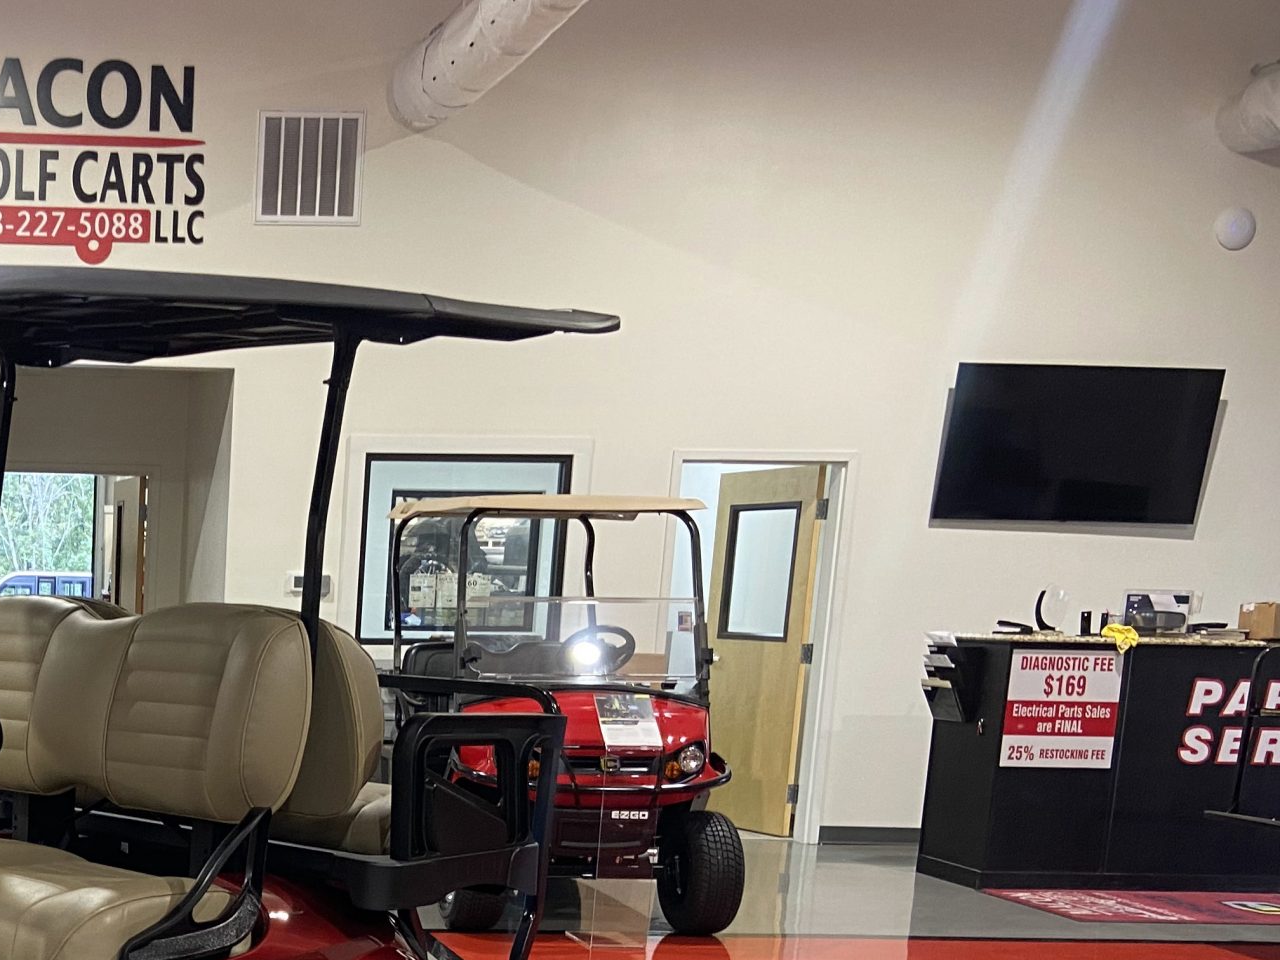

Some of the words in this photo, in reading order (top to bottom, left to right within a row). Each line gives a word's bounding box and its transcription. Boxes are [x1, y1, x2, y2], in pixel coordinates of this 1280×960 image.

[72, 150, 206, 206] CARTS
[154, 209, 205, 245] LLC
[1020, 655, 1090, 672] DIAGNOSTIC
[1093, 657, 1115, 672] FEE
[1043, 673, 1087, 698] $169
[1012, 703, 1056, 718] Electrical
[1058, 704, 1083, 718] Parts
[1085, 705, 1111, 719] Sales
[1036, 722, 1052, 733] are
[1054, 719, 1083, 733] FINAL
[1007, 745, 1035, 761] 25%
[1039, 748, 1089, 760] RESTOCKING
[1091, 749, 1106, 760] FEE
[611, 810, 649, 820] EZGO
